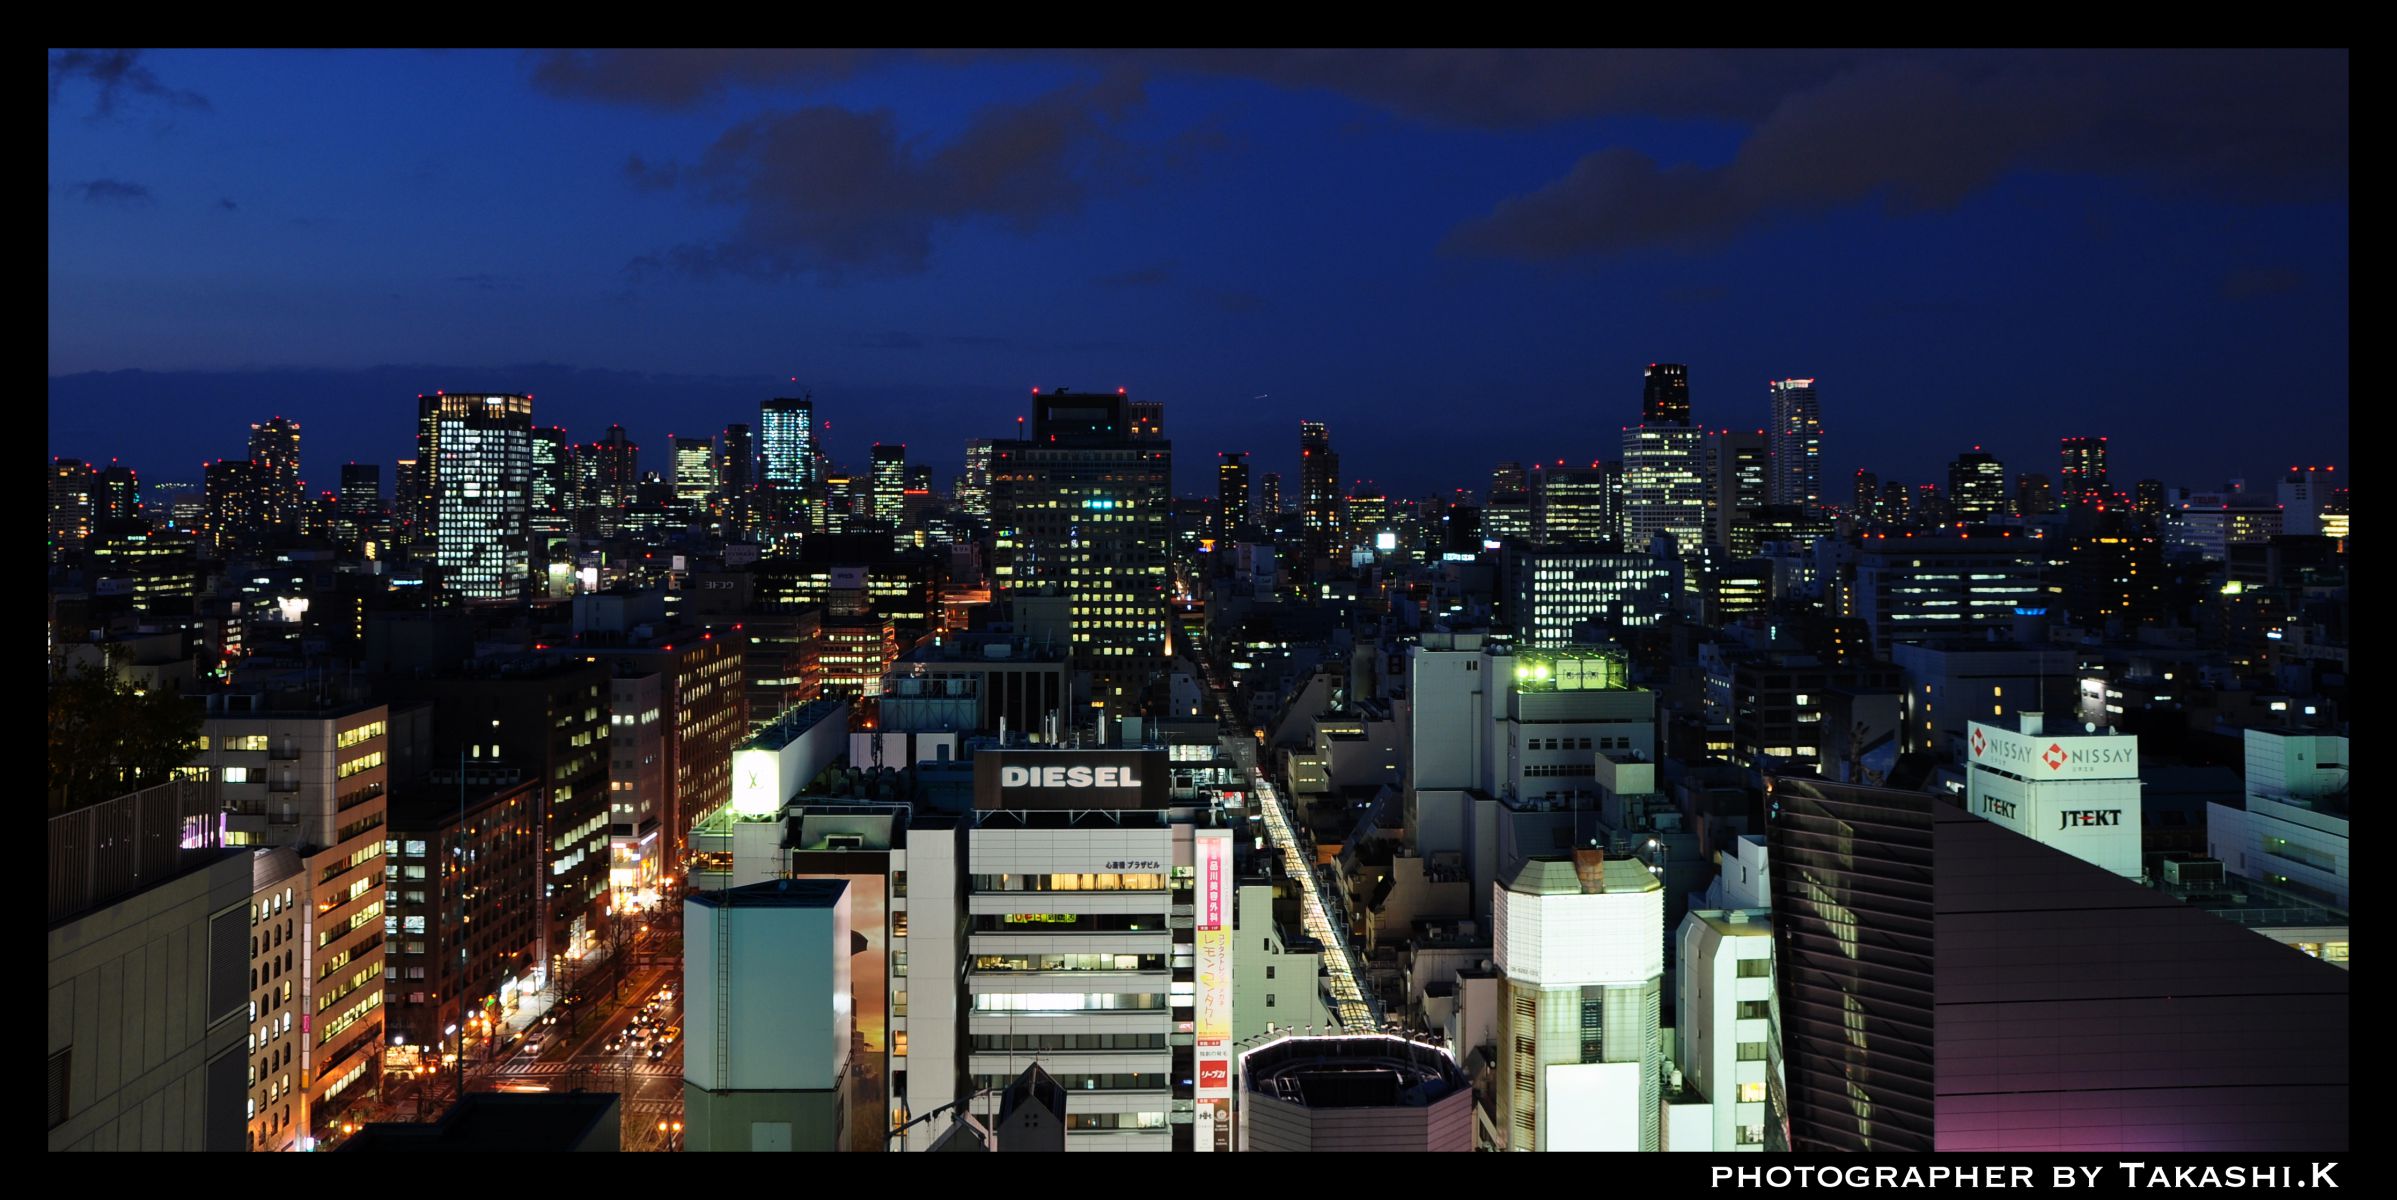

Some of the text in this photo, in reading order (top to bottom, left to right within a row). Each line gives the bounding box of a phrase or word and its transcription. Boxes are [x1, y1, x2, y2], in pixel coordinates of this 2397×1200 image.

[1990, 738, 2032, 763] NISSAY
[2072, 748, 2132, 763] NISSAY
[1001, 766, 1142, 788] DIESEL
[1982, 794, 2017, 820] JTEKT
[2058, 809, 2122, 831] JTEKT
